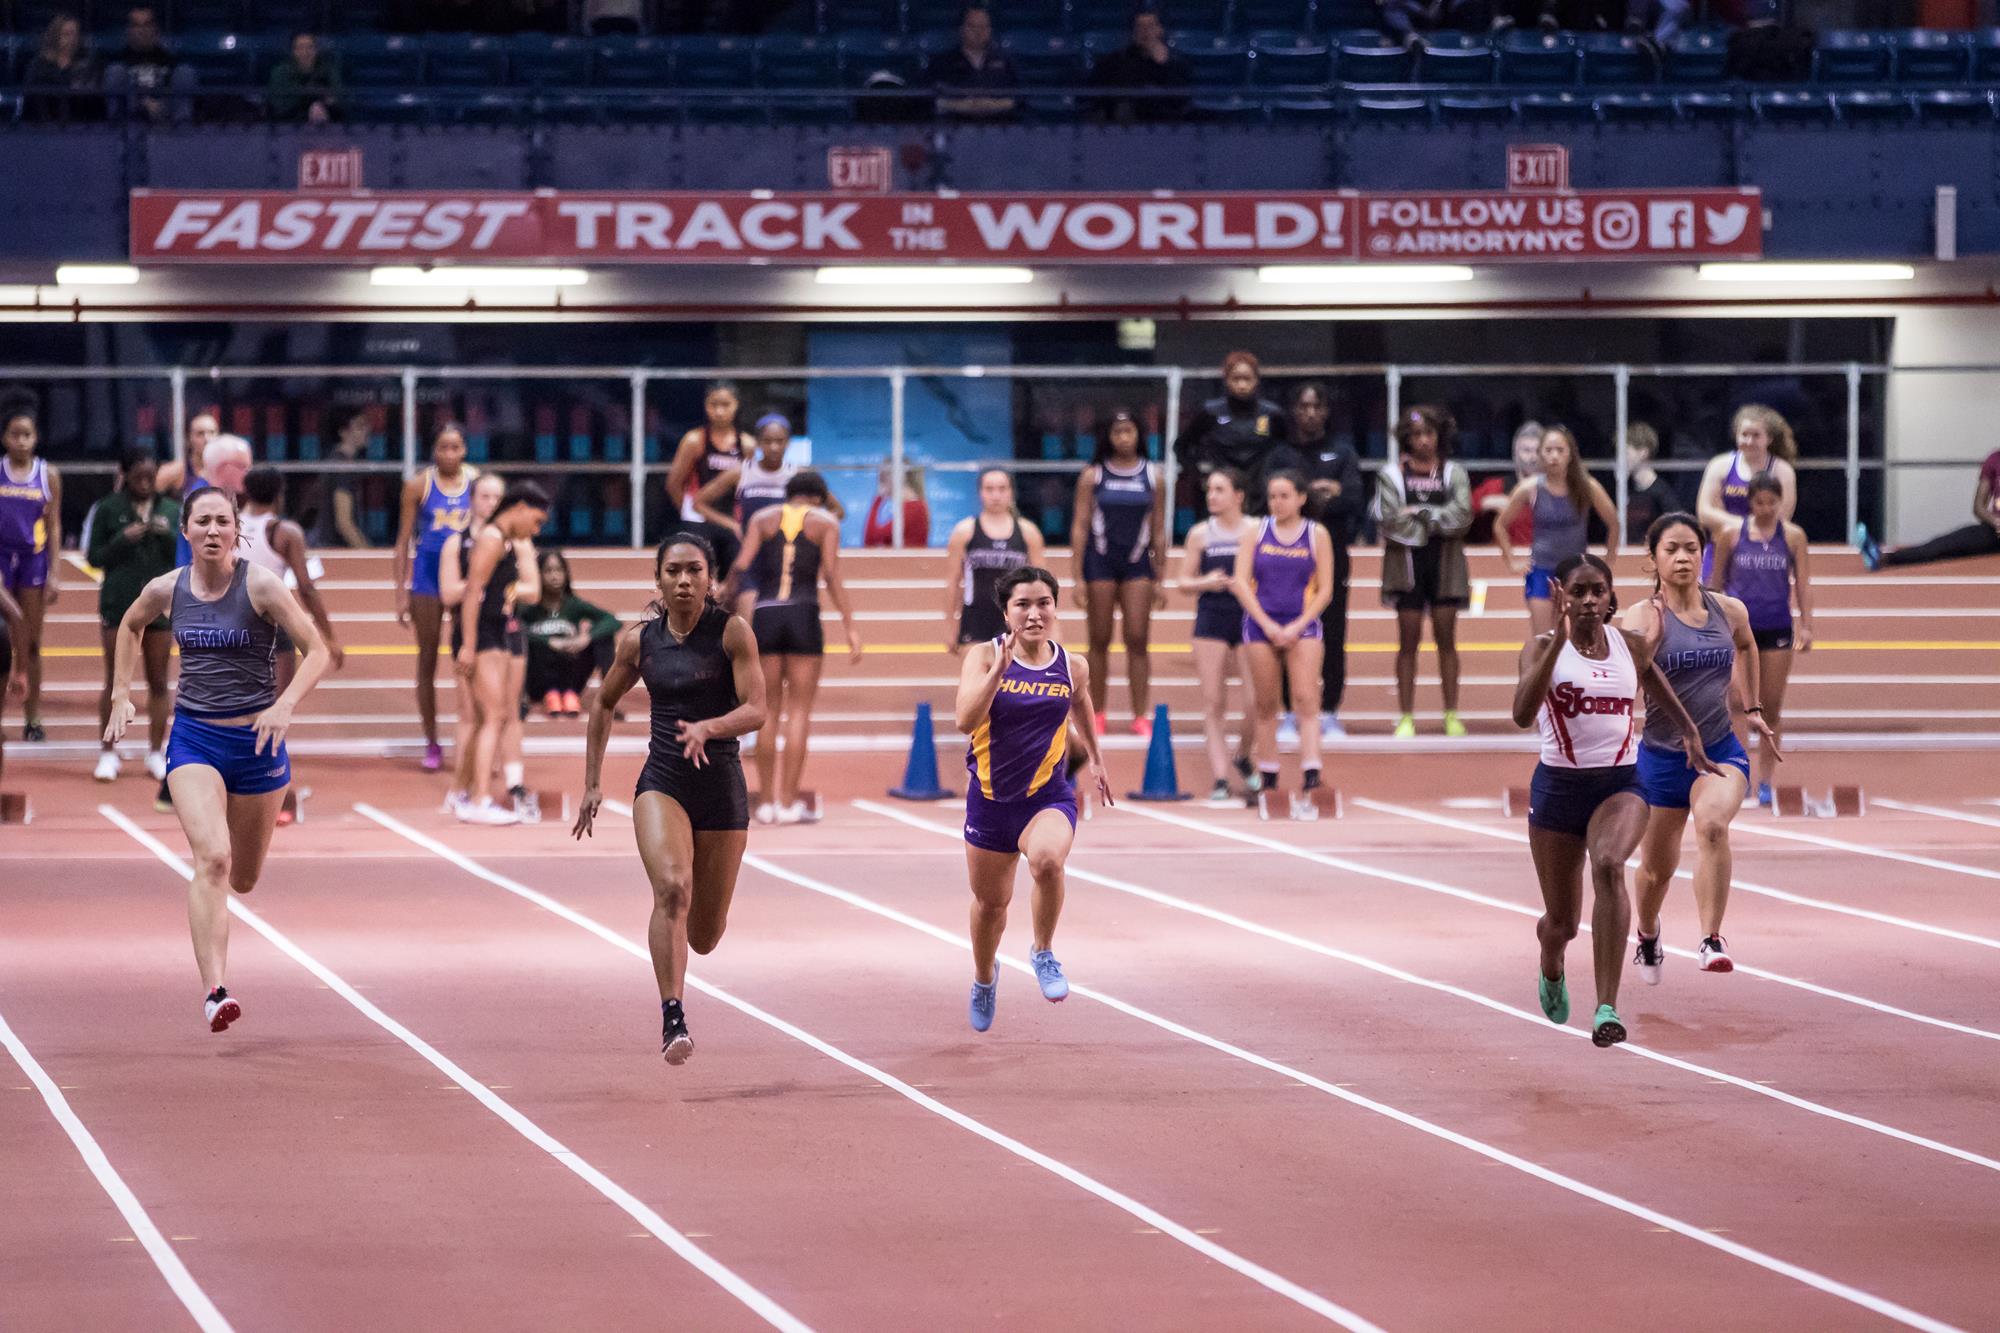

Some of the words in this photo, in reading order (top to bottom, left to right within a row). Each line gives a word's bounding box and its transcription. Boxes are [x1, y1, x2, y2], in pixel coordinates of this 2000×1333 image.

[302, 154, 348, 185] EXIT
[831, 156, 878, 186] EXIT
[1510, 153, 1555, 184] EXIT
[153, 200, 528, 250] FASTEST
[558, 201, 863, 250] TRACK
[901, 202, 933, 225] IN
[967, 201, 1344, 250] WORLD!
[1368, 200, 1527, 227] FOLLOW
[1536, 199, 1585, 225] US
[888, 227, 947, 250] THE
[1370, 230, 1585, 252] @ARMORYNYC
[1000, 678, 1072, 699] HUNTER
